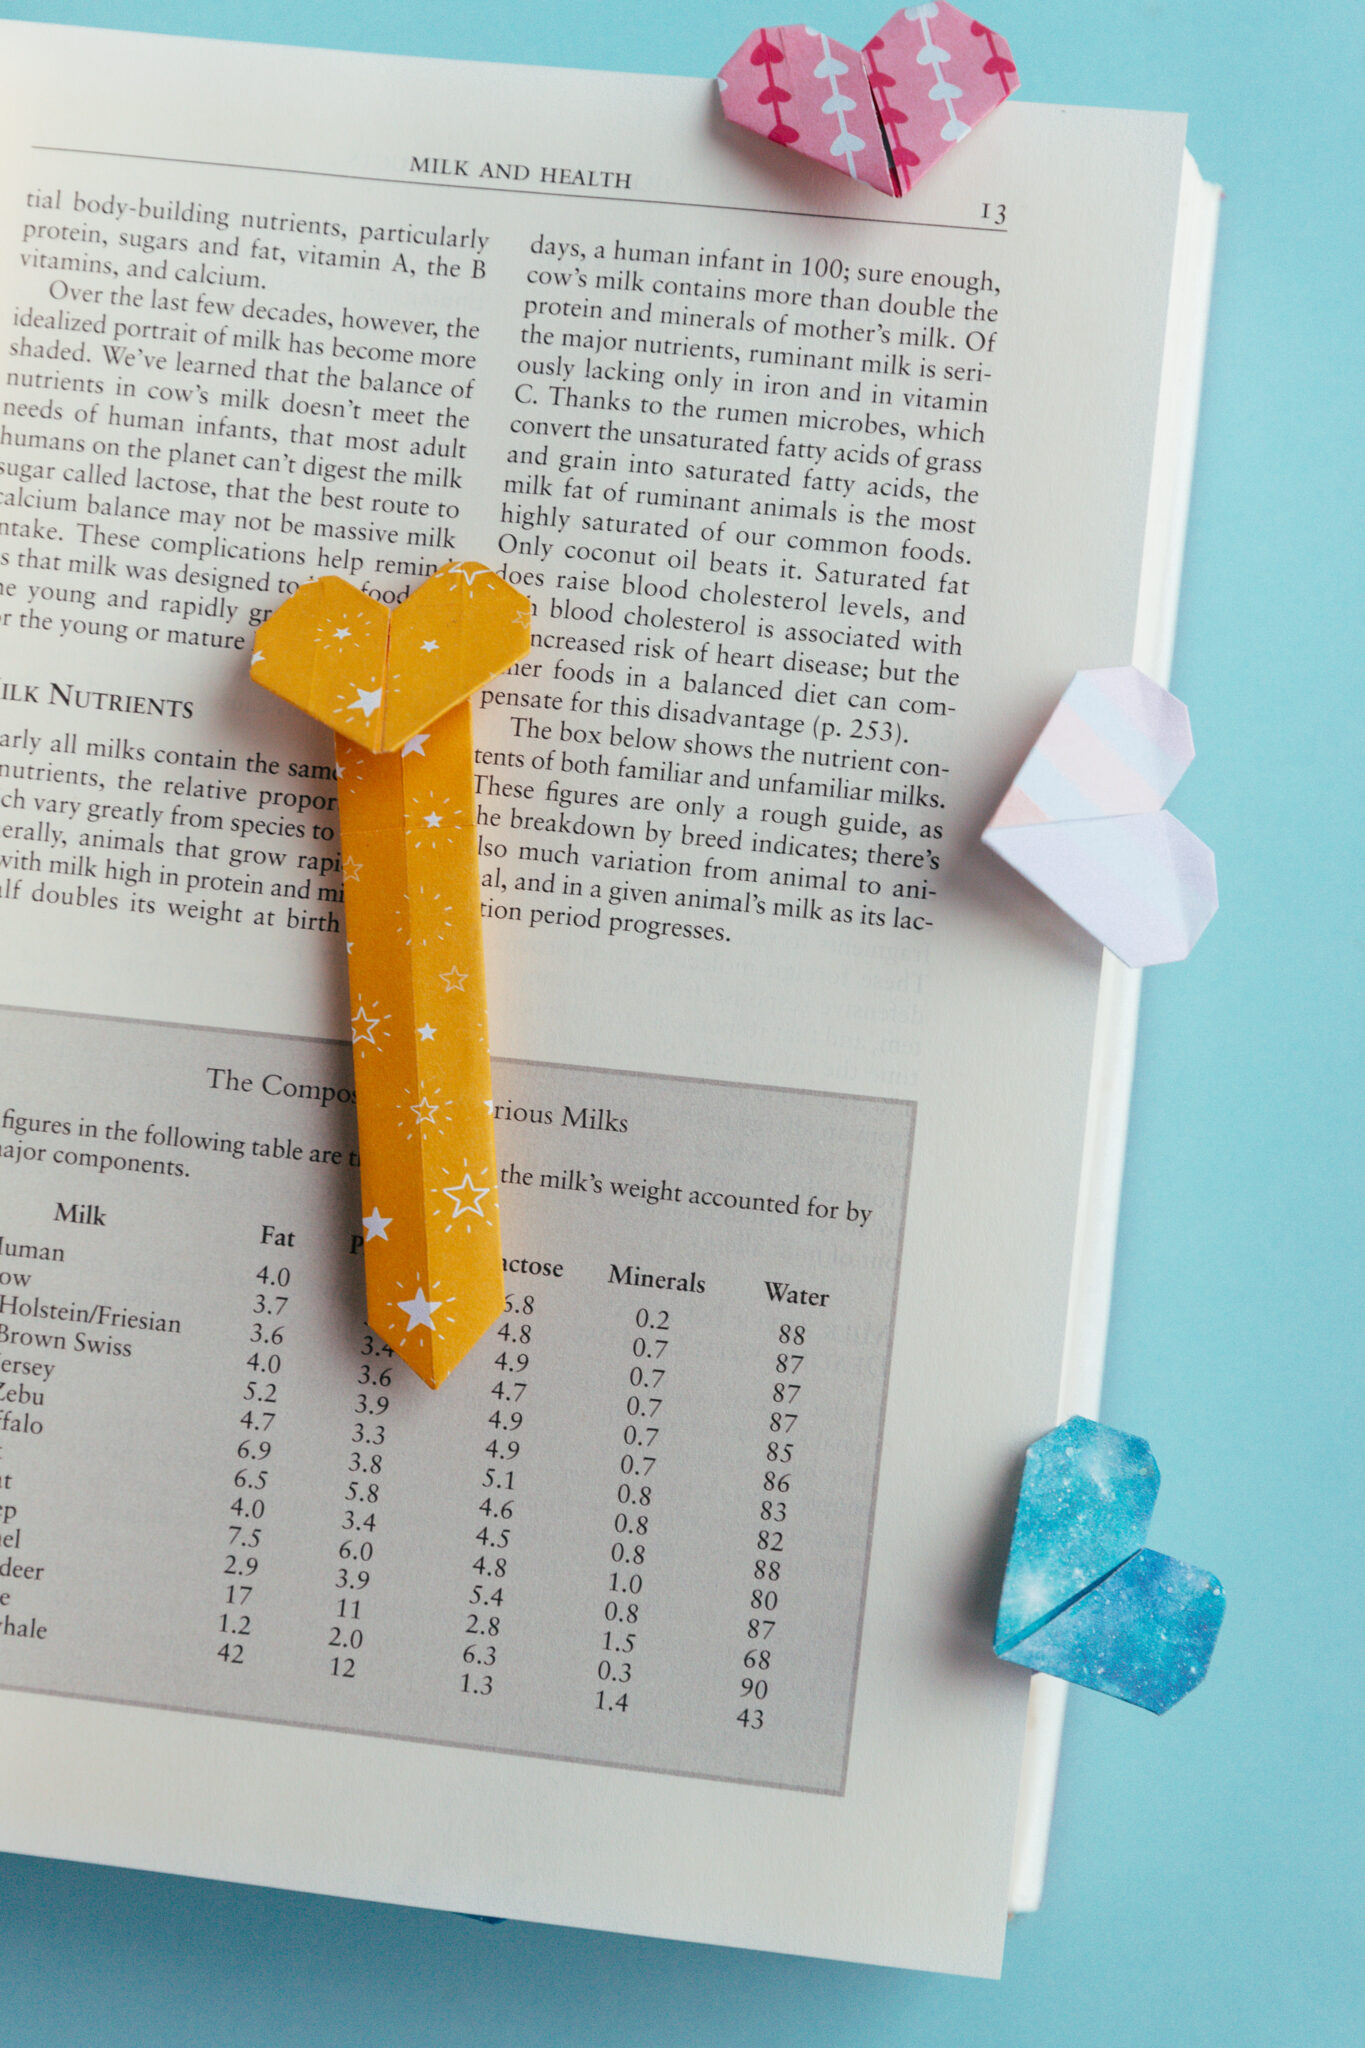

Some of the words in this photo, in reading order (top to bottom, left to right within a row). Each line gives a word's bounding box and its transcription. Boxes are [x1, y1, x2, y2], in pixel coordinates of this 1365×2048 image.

[409, 156, 469, 177] MILK
[478, 161, 530, 181] AND
[540, 166, 632, 190] HEALTH
[26, 188, 62, 210] tial
[73, 190, 230, 231] body-building
[240, 212, 348, 241] nutrients,
[358, 223, 490, 255] particularly
[981, 202, 1006, 225] 13
[22, 222, 108, 248] protein,
[118, 232, 189, 254] sugars
[198, 235, 240, 257] and
[250, 237, 286, 265] fat,
[297, 244, 381, 271] vitamin
[391, 252, 416, 278] A,
[426, 254, 462, 278] the
[470, 258, 487, 280] B
[530, 233, 586, 262] days,
[593, 245, 606, 260] a
[613, 239, 690, 266] human
[698, 246, 766, 273] infant
[771, 253, 792, 275] in
[801, 256, 850, 284] 100;
[856, 266, 904, 285] sure
[910, 269, 1001, 297] enough,
[48, 279, 104, 304] Over
[110, 284, 144, 308] the
[150, 287, 190, 313] last
[195, 292, 235, 317] few
[241, 297, 334, 331] decades,
[341, 306, 439, 341] however,
[446, 316, 481, 340] the
[514, 383, 538, 405] C.
[548, 385, 631, 413] Thanks
[640, 398, 663, 415] to
[672, 395, 707, 419] the
[715, 406, 788, 426] rumen
[797, 409, 907, 441] microbes,
[917, 418, 985, 444] which
[3, 398, 63, 421] needs
[73, 402, 100, 424] of
[107, 404, 184, 433] human
[195, 414, 278, 446] infants,
[290, 423, 335, 448] that
[344, 435, 400, 454] most
[409, 435, 468, 460] adult
[62, 462, 127, 487] called
[135, 467, 217, 500] lactose,
[225, 477, 271, 502] that
[277, 482, 313, 506] the
[320, 485, 365, 511] best
[370, 498, 430, 517] route
[437, 501, 460, 519] to
[503, 473, 553, 497] milk
[563, 476, 594, 500] fat
[602, 481, 629, 503] of
[635, 488, 741, 514] ruminant
[749, 496, 837, 522] animals
[847, 503, 865, 525] is
[875, 505, 911, 529] the
[919, 516, 977, 535] most
[555, 570, 610, 593] raise
[622, 572, 689, 600] blood
[699, 581, 827, 613] cholesterol
[839, 593, 910, 625] levels,
[922, 604, 966, 626] and
[48, 682, 194, 720] NUTRIENTS
[49, 732, 77, 754] all
[86, 737, 146, 762] milks
[153, 748, 237, 771] contain
[245, 751, 281, 776] the
[474, 748, 525, 769] tents
[531, 749, 557, 771] of
[560, 750, 610, 777] both
[616, 755, 704, 785] familiar
[708, 768, 751, 790] and
[757, 772, 874, 802] unfamiliar
[878, 783, 946, 810] milks.
[34, 797, 82, 820] vary
[86, 801, 164, 829] greatly
[170, 803, 224, 830] from
[230, 815, 306, 839] species
[312, 827, 336, 846] to
[517, 842, 579, 865] much
[591, 849, 692, 877] variation
[703, 856, 758, 883] from
[769, 866, 848, 892] animal
[858, 877, 882, 896] to
[892, 879, 937, 900] ani-
[31, 881, 118, 911] doubles
[130, 892, 156, 914] its
[167, 899, 244, 926] weight
[252, 911, 276, 927] at
[287, 907, 341, 934] birth
[528, 905, 602, 929] period
[607, 916, 731, 943] progresses.
[206, 1067, 253, 1093] The
[560, 1105, 629, 1133] Milks
[2, 1107, 72, 1136] figures
[78, 1117, 99, 1139] in
[105, 1119, 139, 1143] the
[144, 1124, 247, 1160] following
[252, 1138, 304, 1161] table
[308, 1145, 343, 1166] are
[52, 1147, 190, 1179] components.
[500, 1163, 534, 1187] the
[539, 1168, 603, 1194] milk's
[608, 1178, 684, 1206] weight
[688, 1190, 800, 1216] accounted
[806, 1195, 840, 1220] for
[846, 1199, 874, 1229] by
[53, 1202, 108, 1227] Milk
[260, 1225, 296, 1249] Fat
[256, 1265, 292, 1288] 4.0
[606, 1263, 707, 1295] Minerals
[762, 1280, 831, 1308] Water
[635, 1307, 670, 1331] 0.2
[249, 1322, 286, 1346] 3.6
[778, 1323, 806, 1346] 88
[493, 1350, 530, 1374] 4.9
[629, 1365, 667, 1389] 0.7
[353, 1392, 391, 1416] 3.9
[772, 1382, 802, 1405] 87
[487, 1409, 524, 1432] 4.9
[623, 1423, 660, 1448] 0.7
[236, 1439, 272, 1461] 6.9
[766, 1440, 795, 1464] 85
[347, 1451, 383, 1475] 3.8
[481, 1467, 515, 1491] 5.1
[616, 1482, 652, 1507] 0.8
[759, 1499, 787, 1523] 83
[228, 1524, 263, 1549] 7.5
[338, 1539, 374, 1562] 6.0
[471, 1555, 508, 1579] 4.8
[608, 1571, 643, 1595] 1.0
[750, 1588, 779, 1612] 80
[218, 1612, 251, 1636] 1.2
[327, 1626, 364, 1650] 2.0
[216, 1642, 245, 1665] 42
[462, 1643, 497, 1667] 6.3
[330, 1655, 356, 1679] 12
[597, 1659, 632, 1684] 0.3
[460, 1672, 493, 1696] 1.3
[739, 1677, 769, 1701] 90
[594, 1689, 629, 1713] 1.4
[735, 1707, 764, 1730] 43
